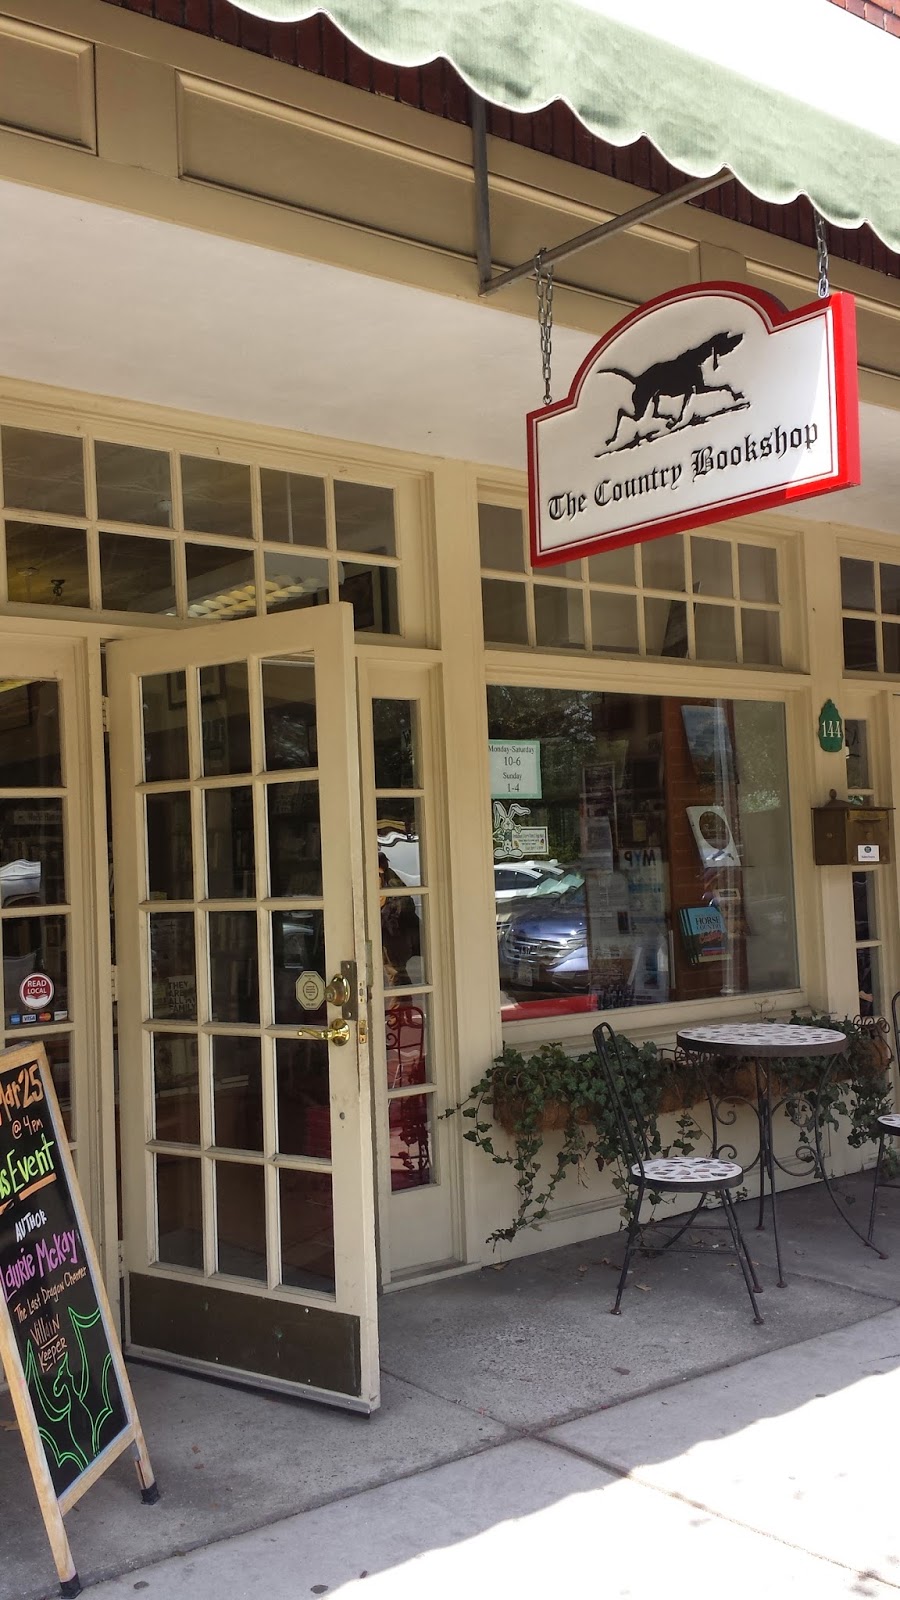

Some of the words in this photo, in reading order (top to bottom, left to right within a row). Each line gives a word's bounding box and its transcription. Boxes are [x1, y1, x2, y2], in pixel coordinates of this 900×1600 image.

[548, 491, 587, 521] The
[593, 466, 682, 508] Country
[692, 422, 819, 482] Bookshop
[822, 720, 841, 738] 144
[504, 756, 521, 766] 10-6
[503, 772, 522, 781] Sunday
[508, 783, 520, 793] 1-4
[19, 1063, 44, 1107] 25
[11, 1120, 22, 1139] @
[7, 1133, 54, 1193] Event
[15, 1209, 47, 1242] AUTHOR
[14, 1301, 28, 1324] The
[27, 1296, 42, 1315] Last
[41, 1280, 65, 1303] Dragon
